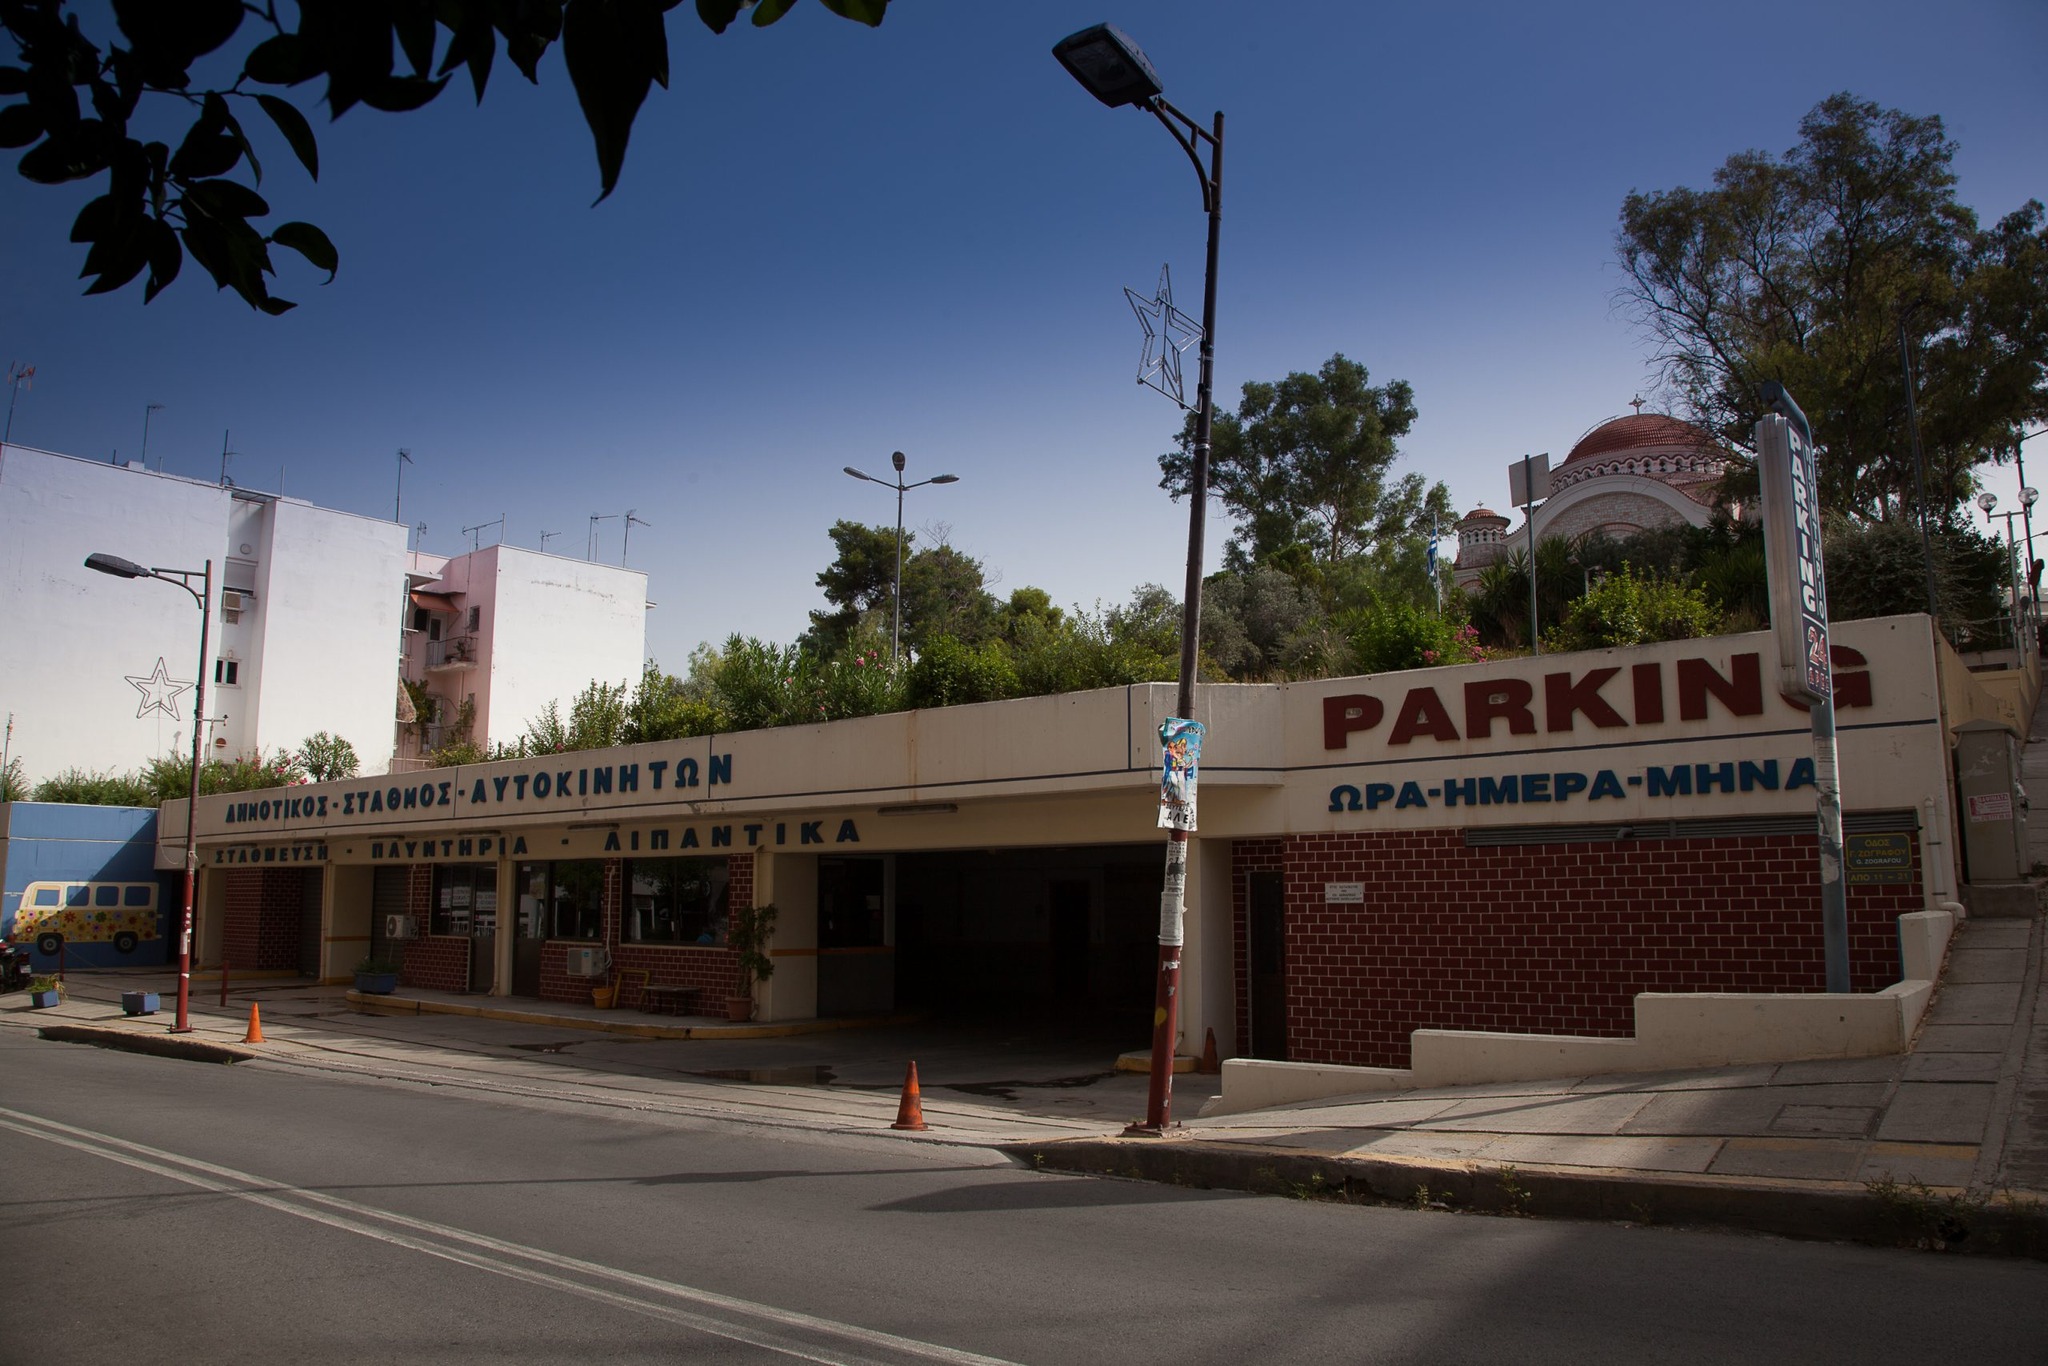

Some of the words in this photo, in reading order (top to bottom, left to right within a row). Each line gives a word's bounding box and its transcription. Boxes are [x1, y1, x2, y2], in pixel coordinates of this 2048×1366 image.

[1788, 425, 1817, 613] PARKING
[1808, 626, 1828, 671] 24
[1323, 645, 1873, 750] PARKING
[343, 782, 451, 814] ΣΤΑΘΜΟΣ
[471, 753, 732, 803] ΑΥΤΟΚΙΝΗΤΩΝ
[216, 845, 329, 864] ΣΤΑΘΜΕΥΣΗ
[371, 836, 528, 859] ΠΛΥΝΤΗΡΙΑ
[604, 819, 860, 851] ΛΙΠΑΝΤΙΚΑ
[1864, 839, 1891, 848] ΟΔΟΣ
